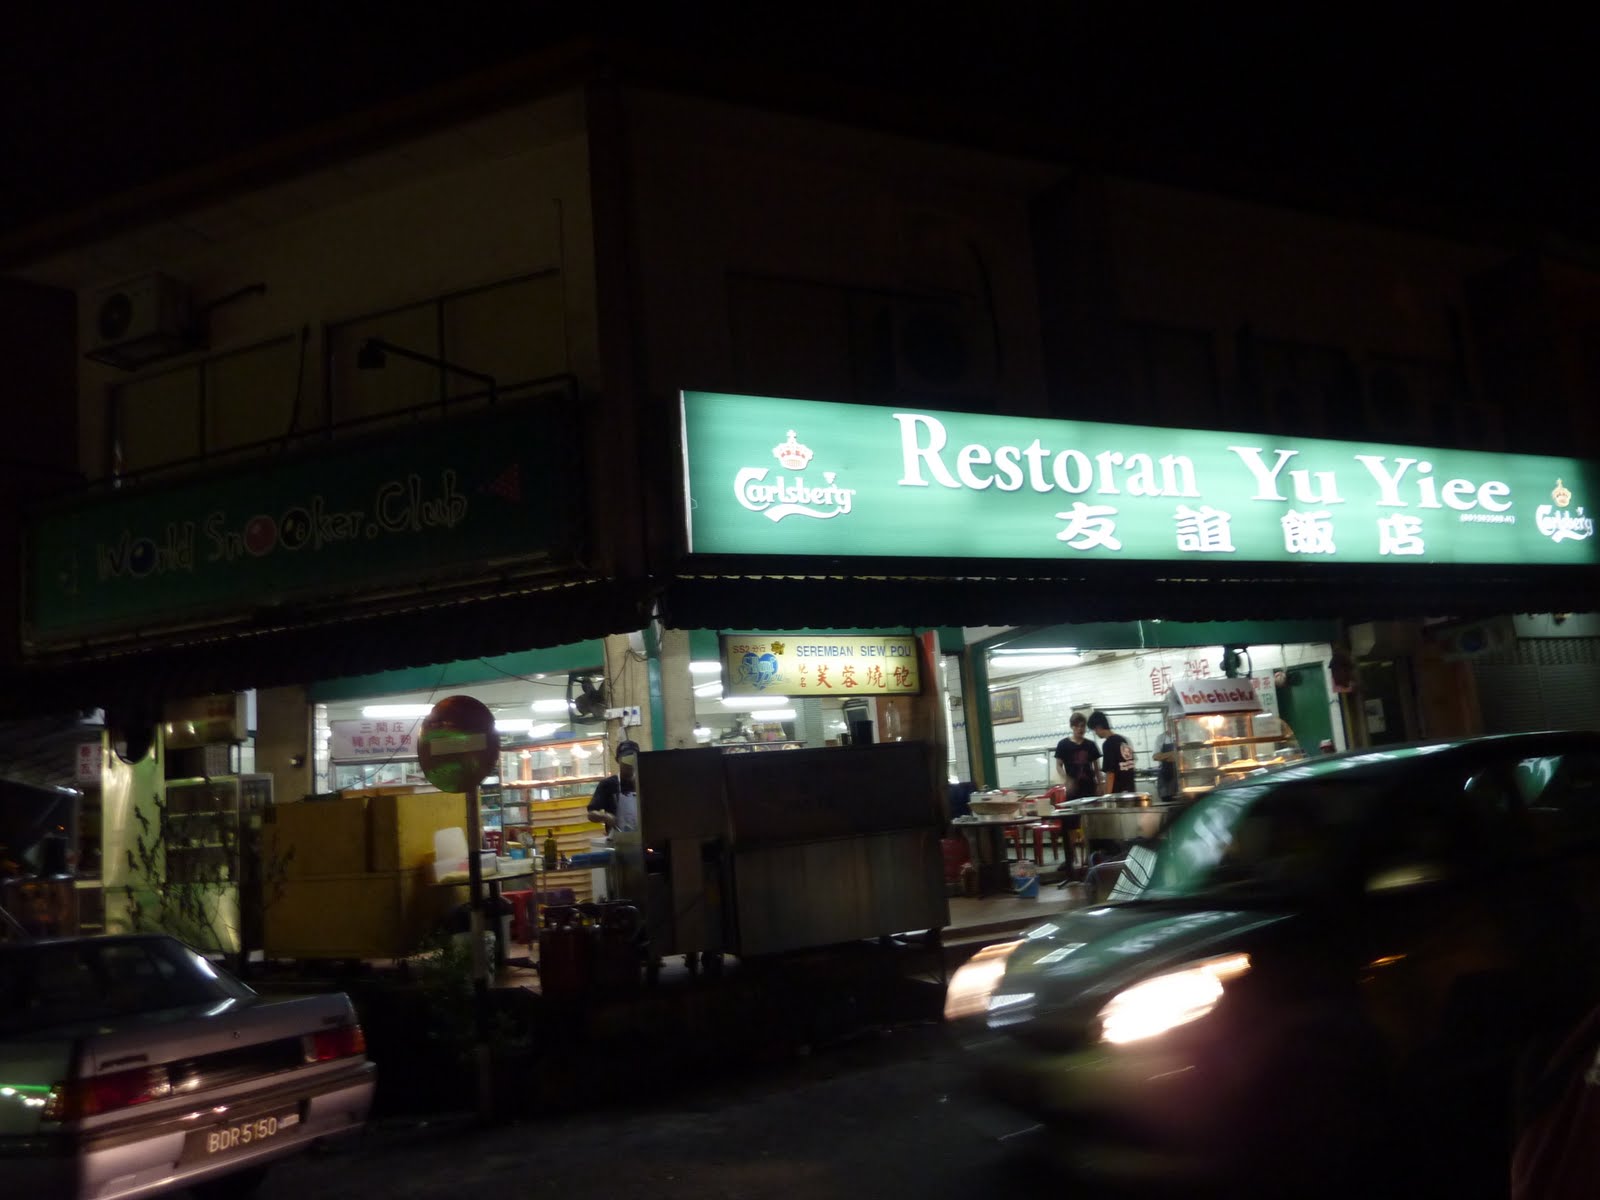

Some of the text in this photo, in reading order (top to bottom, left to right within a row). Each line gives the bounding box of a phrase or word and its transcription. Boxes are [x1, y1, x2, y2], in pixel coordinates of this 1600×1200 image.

[893, 413, 1513, 512] Restoran Yu Yiee
[734, 467, 856, 522] Carlsberg
[1055, 501, 1425, 556] 友誼飯店
[1536, 504, 1594, 543] Carlsberg
[796, 645, 912, 657] SEREMBAN SIEW POU
